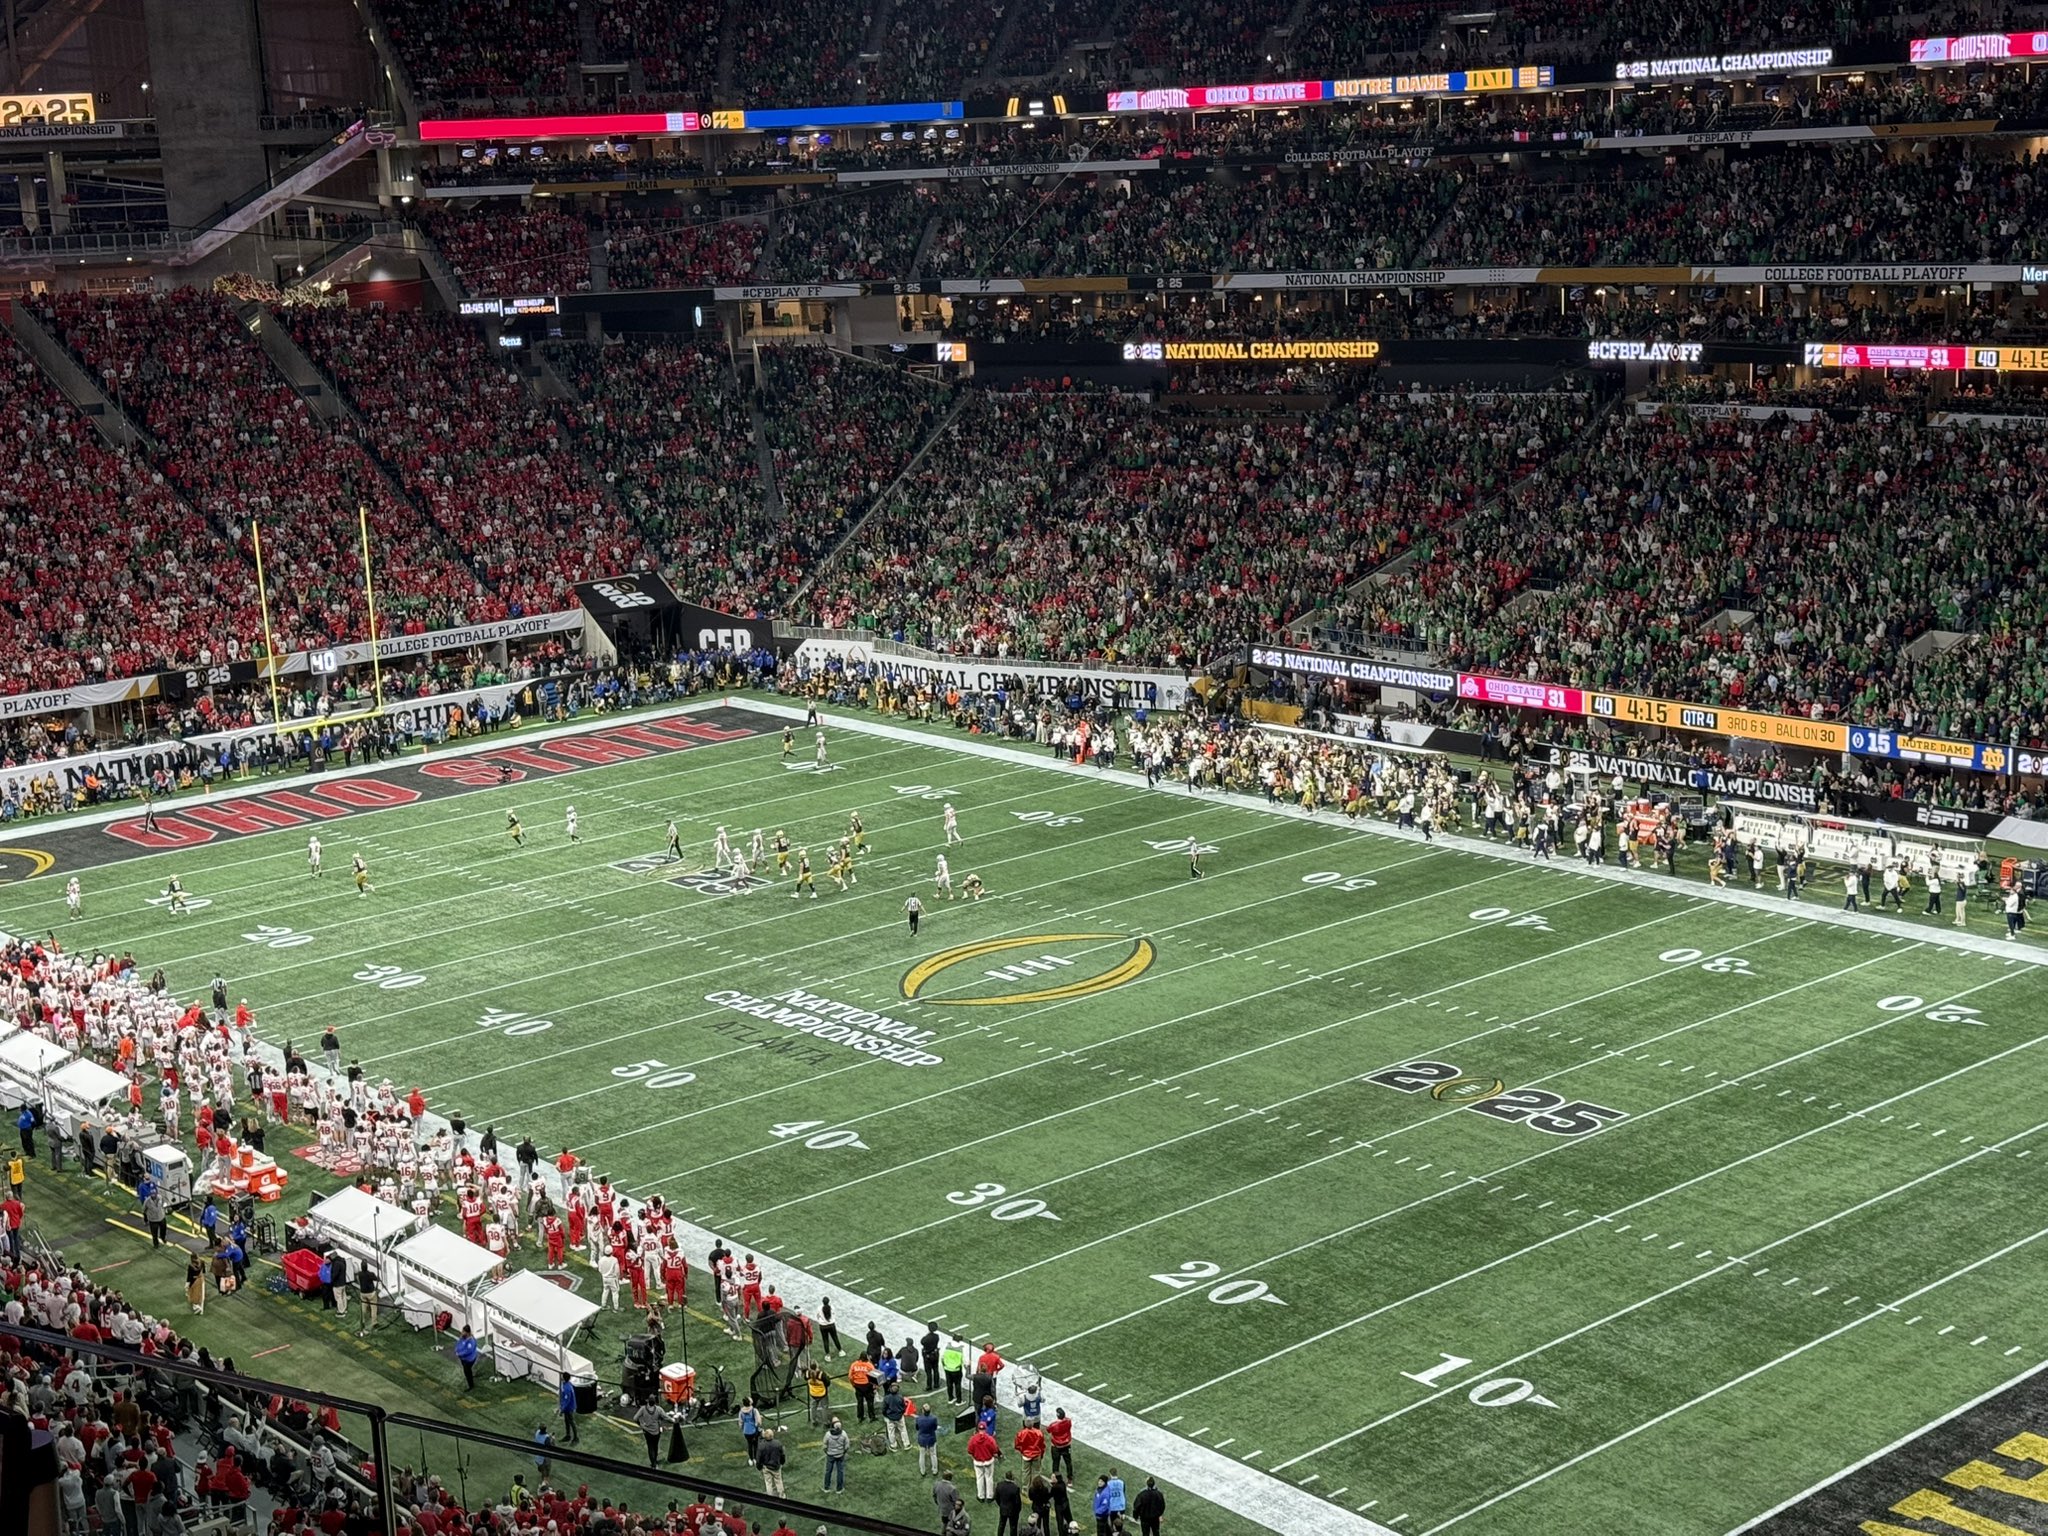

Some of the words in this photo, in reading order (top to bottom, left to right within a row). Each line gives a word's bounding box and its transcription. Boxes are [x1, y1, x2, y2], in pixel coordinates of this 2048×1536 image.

[1650, 57, 1720, 77] NATIONAL
[1722, 49, 1832, 72] CHAMPIONSHIP
[1206, 86, 1249, 104] OHIO
[1253, 83, 1306, 101] STATE
[1333, 77, 1393, 96] NOTRE
[1396, 74, 1449, 93] DAME
[31, 125, 116, 137] CHAMPIONSHIP
[1687, 131, 1753, 144] #CFBPLAYFF
[1285, 151, 1331, 162] COLLEGE
[1333, 149, 1386, 161] FOOTBALL
[1387, 147, 1434, 159] PLAYOFF
[947, 166, 993, 177] NATIONAL
[994, 163, 1060, 176] CHAMPIONSHIP
[626, 180, 658, 190] ATLANTA
[1285, 273, 1347, 286] NATIONAL
[1349, 271, 1446, 285] CHAMPIONSHIP
[1765, 268, 1823, 281] COLLEGE
[1827, 268, 1899, 281] FOOTBALL
[1902, 267, 1967, 280] PLAYOFF
[741, 286, 822, 298] #CFBPLAYFF
[460, 303, 483, 314] 10:45
[485, 302, 498, 313] PM
[499, 336, 522, 347] Benz
[1165, 342, 1248, 360] NATIONAL
[1250, 341, 1380, 359] CHAMPIONSHIP
[1870, 349, 1892, 357] OHIO
[1894, 349, 1926, 358] STATE
[1930, 349, 1949, 366] 31
[1978, 351, 1997, 367] 40
[376, 637, 430, 657] COLLEGE
[433, 628, 496, 649] FOOTBALL
[498, 618, 551, 638] PLAYOFF
[312, 652, 335, 671] 40
[1285, 653, 1350, 678] NATIONAL
[1351, 662, 1454, 691] CHAMPIONSHIP
[4, 693, 72, 715] PLAYOFF
[1488, 681, 1510, 694] OHIO
[1512, 685, 1544, 698] STATE
[1548, 689, 1567, 709] 31
[1594, 697, 1613, 715] 40
[1628, 699, 1667, 724] 4:15
[1683, 709, 1705, 727] QTR
[1706, 712, 1715, 728] 4
[1727, 717, 1747, 732] 3RD
[1760, 721, 1767, 734] 9
[1776, 723, 1801, 739] BALL
[1803, 726, 1818, 741] ON
[1820, 728, 1836, 743] 30
[1868, 732, 1891, 755] 15
[1901, 737, 1938, 752] NOTRE
[1940, 742, 1970, 756] DAME
[1594, 755, 1687, 786] NATIONAL
[102, 779, 422, 848] OHIO
[418, 716, 758, 786] STATE
[1017, 811, 1084, 827] 30
[1916, 806, 1970, 830] ESPN
[1302, 871, 1378, 892] 50
[1468, 907, 1549, 930] 40
[241, 926, 314, 949] 20
[1658, 948, 1750, 974] 30
[353, 966, 427, 990] 30
[773, 988, 937, 1046] NATIONAL
[1876, 996, 1982, 1023] 20
[475, 1011, 554, 1037] 40
[703, 990, 943, 1067] CHAMPIONSHIP
[702, 1020, 834, 1066] ATLANTA
[610, 1060, 696, 1089] 50
[165, 1100, 175, 1110] 10
[768, 1120, 858, 1150] 40
[146, 1157, 163, 1181] BIG
[261, 1175, 270, 1185] G
[469, 1203, 479, 1214] 10
[945, 1182, 1047, 1221] 30
[644, 1242, 656, 1251] 30
[669, 1257, 681, 1267] 72
[745, 1270, 758, 1281] 25
[1148, 1260, 1269, 1305] 20
[100, 1316, 111, 1328] 15
[72, 1378, 80, 1393] 4
[1400, 1353, 1534, 1408] 10
